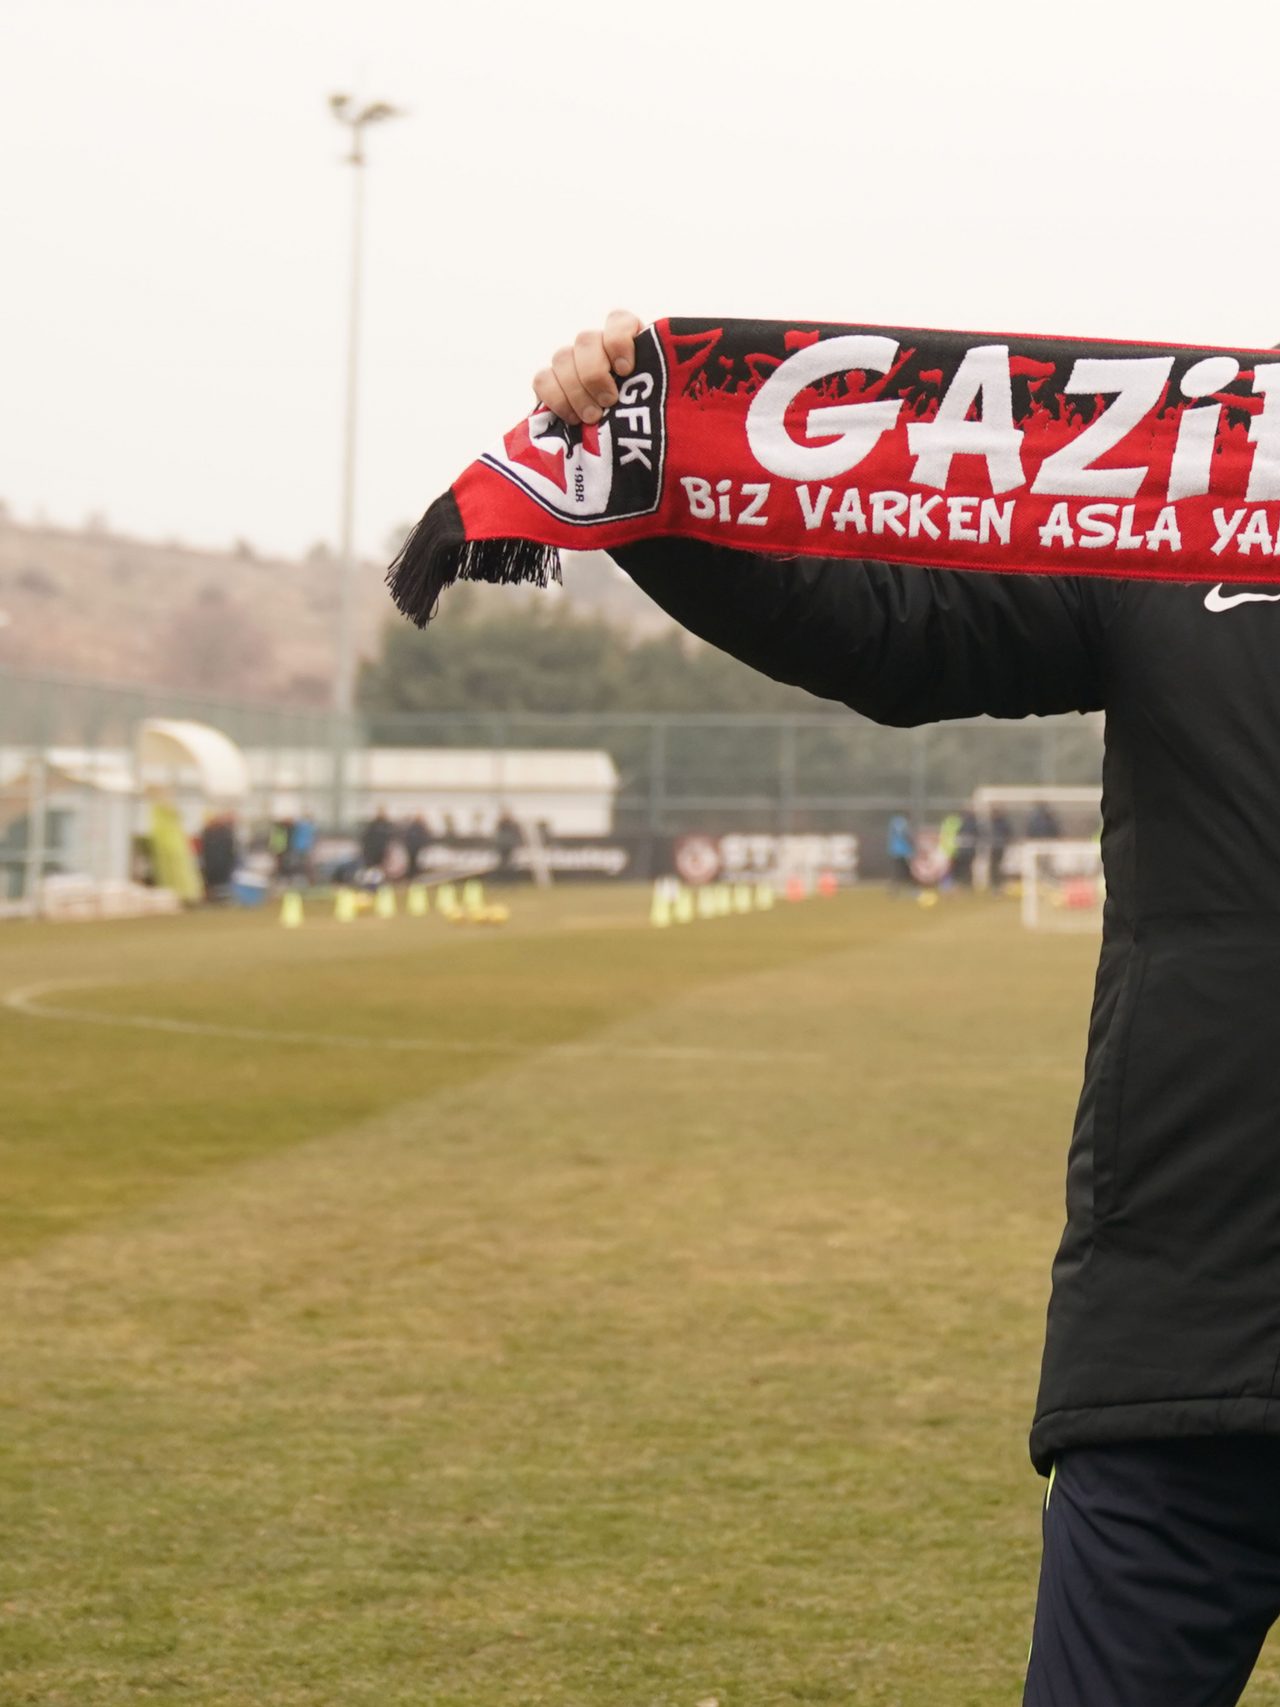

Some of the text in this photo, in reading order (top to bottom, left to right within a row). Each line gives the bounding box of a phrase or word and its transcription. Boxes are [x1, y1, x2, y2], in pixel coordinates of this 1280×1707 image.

[615, 371, 654, 471] GFK
[796, 484, 1017, 545] VARKEN
[1038, 502, 1182, 553] ASLA
